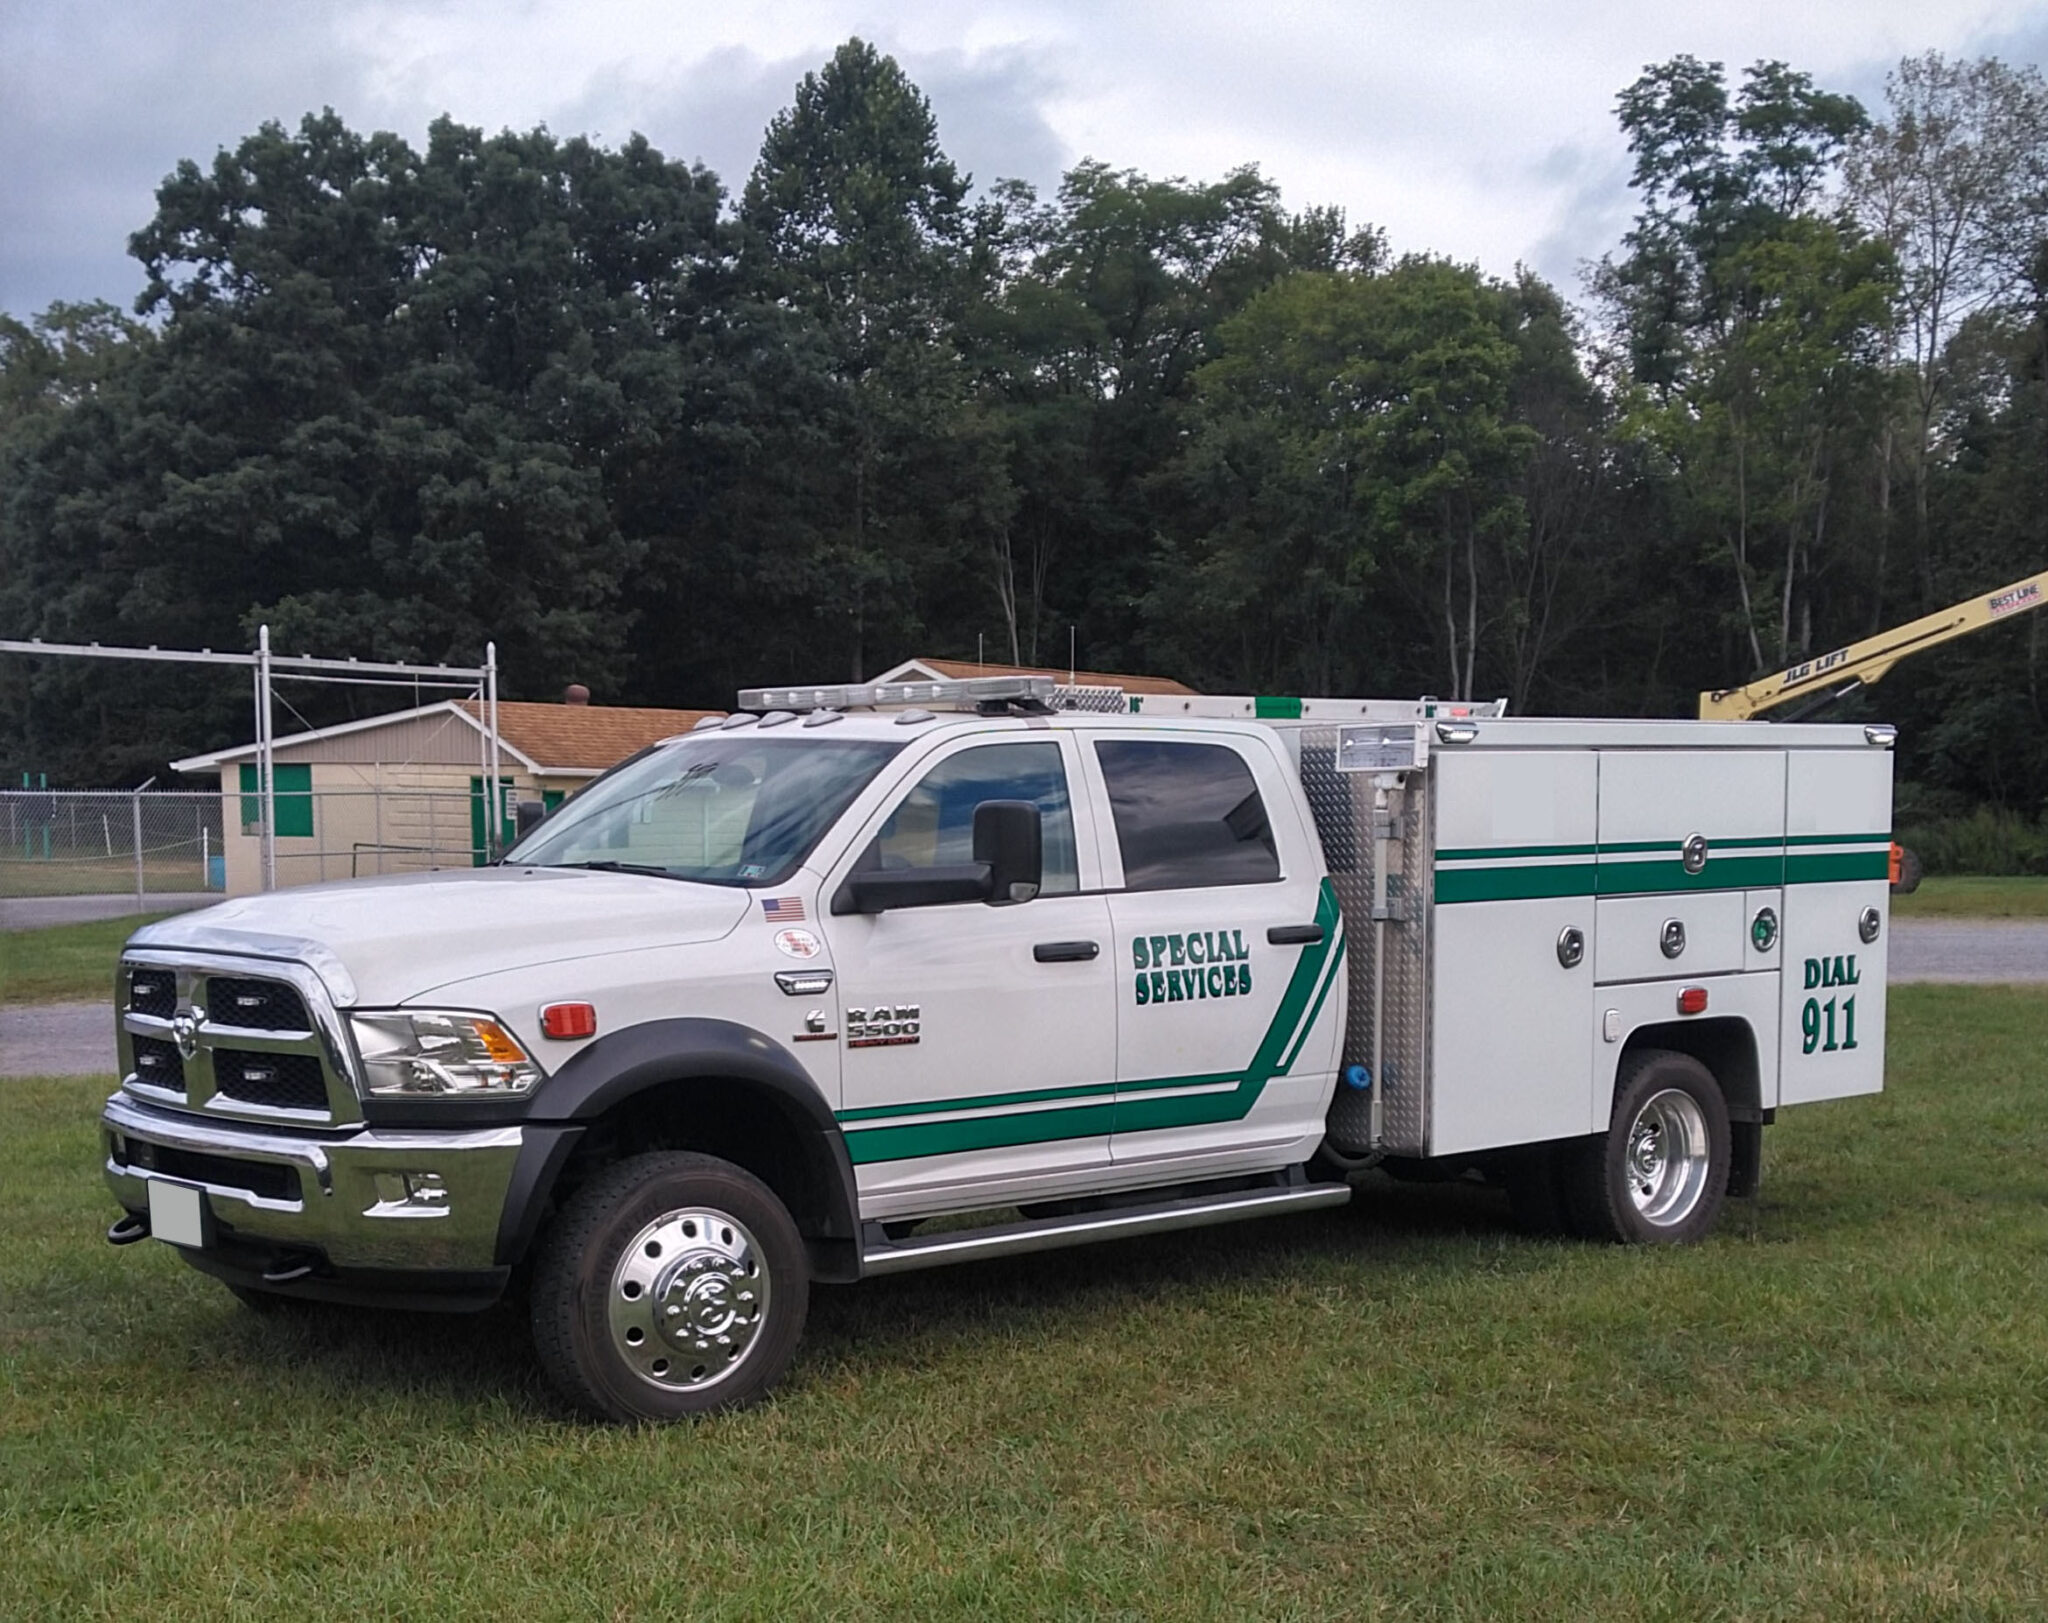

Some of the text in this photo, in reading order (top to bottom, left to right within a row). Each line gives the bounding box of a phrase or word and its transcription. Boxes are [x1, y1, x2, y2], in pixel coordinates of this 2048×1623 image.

[1990, 592, 2015, 609] BEST
[1783, 649, 1849, 684] JLG LIFT
[1132, 929, 1250, 970] SPECIAL
[1135, 963, 1252, 1006] SERVICES
[1803, 954, 1862, 990] DIAL
[847, 1004, 920, 1023] RAM
[847, 1020, 920, 1038] 5500
[1801, 993, 1858, 1055] 911
